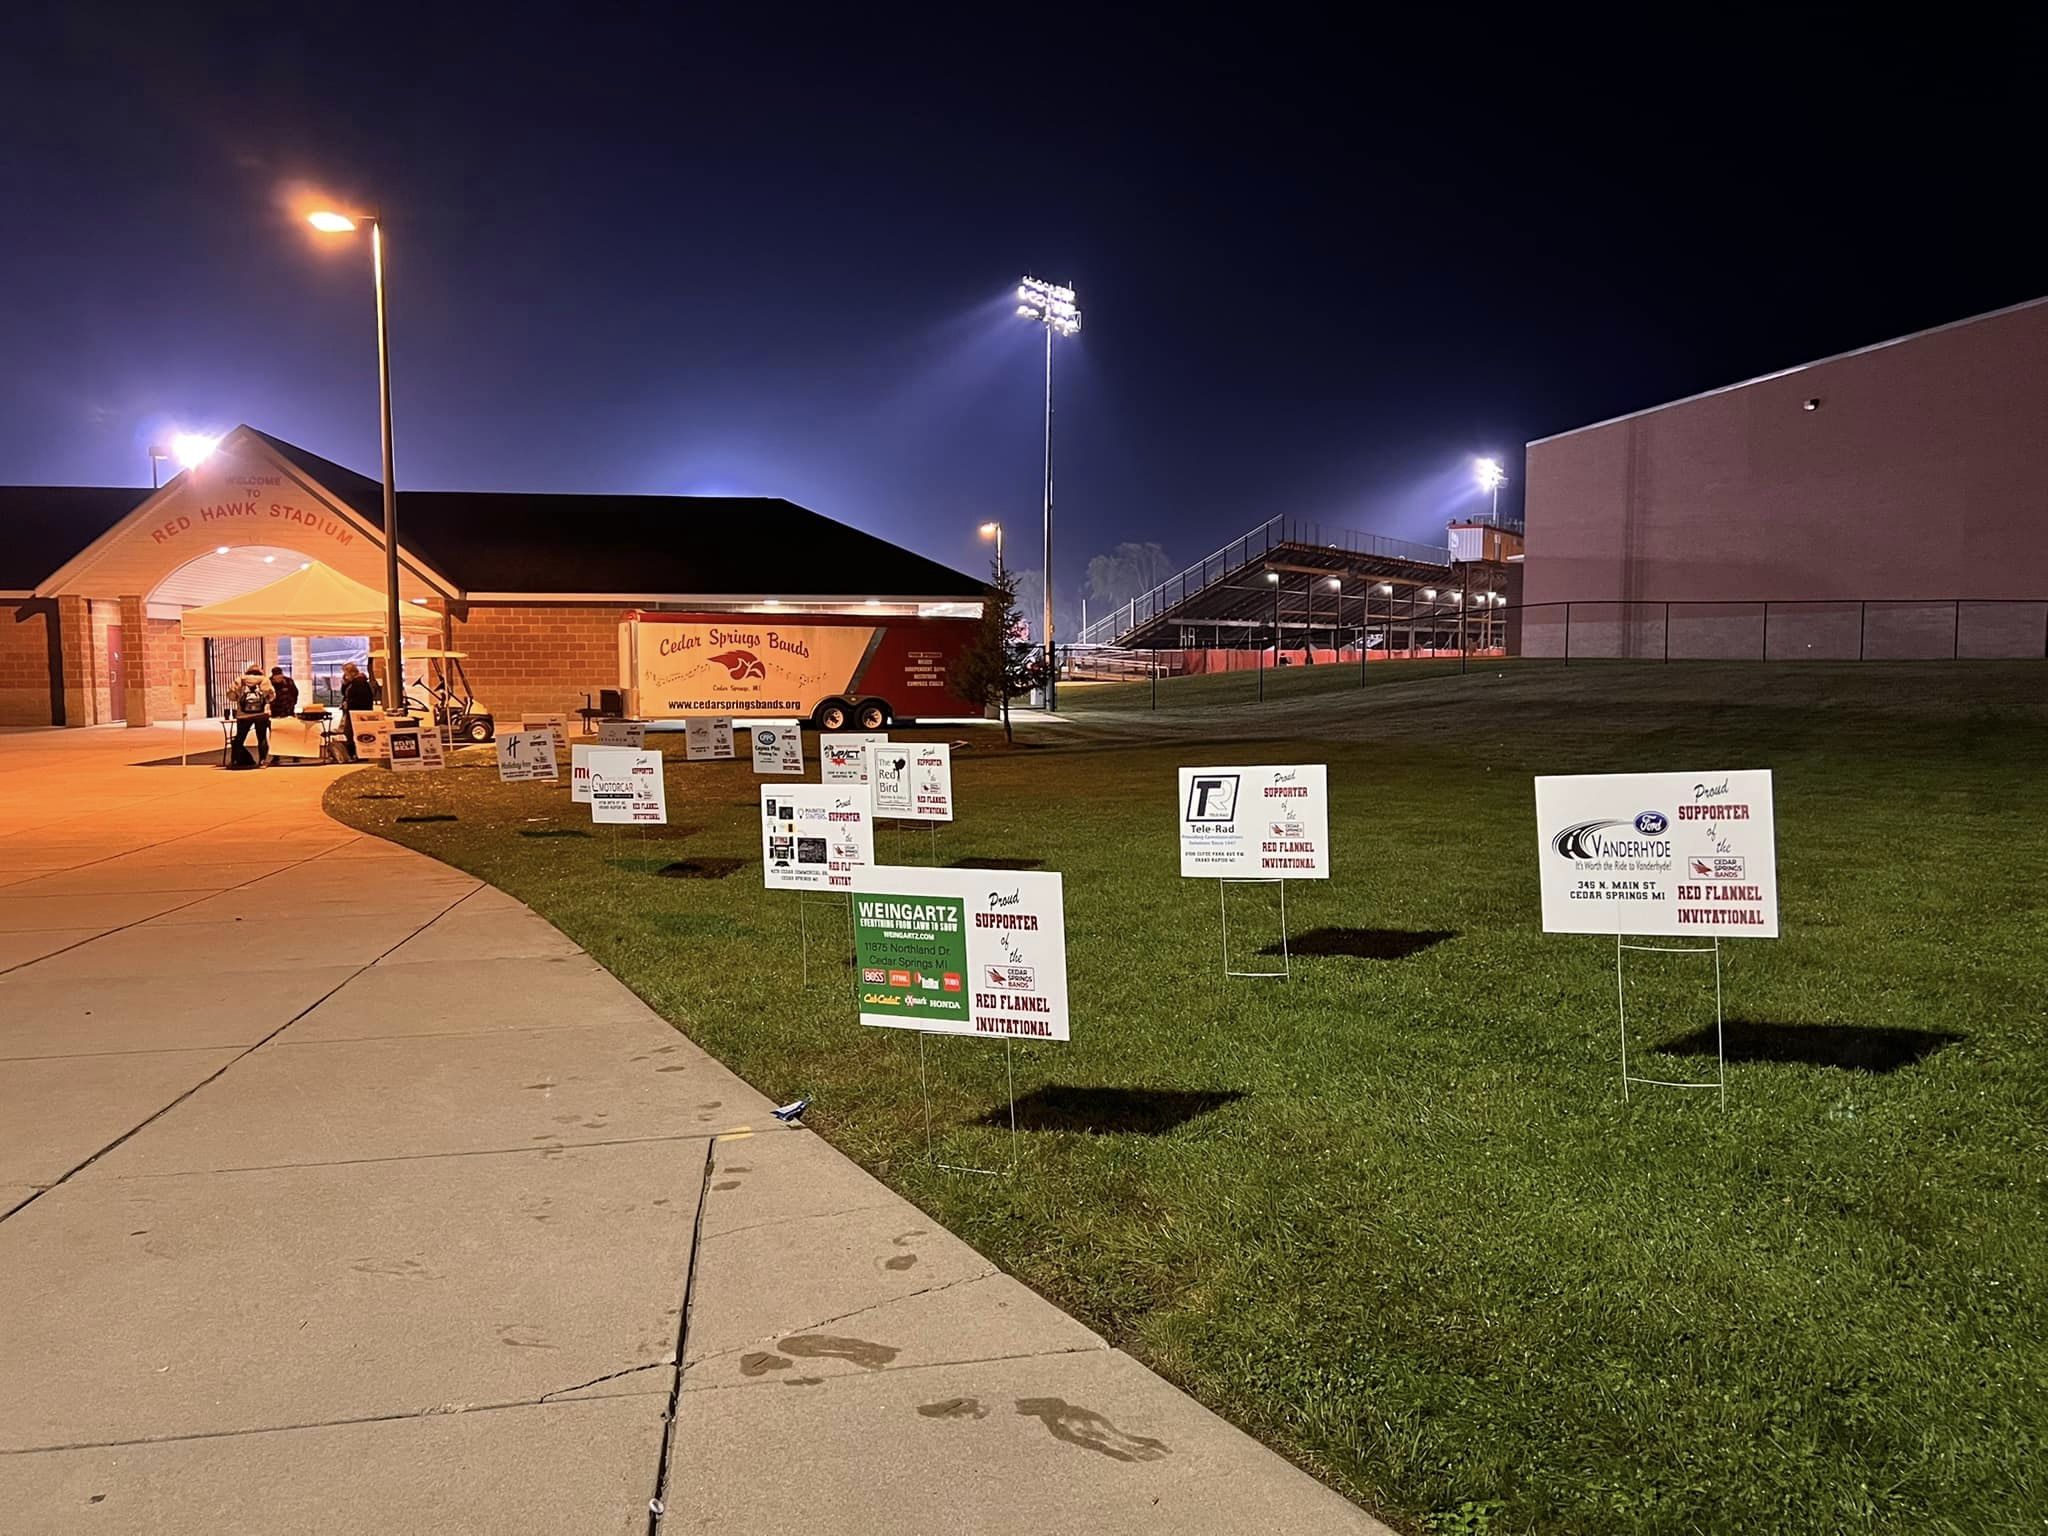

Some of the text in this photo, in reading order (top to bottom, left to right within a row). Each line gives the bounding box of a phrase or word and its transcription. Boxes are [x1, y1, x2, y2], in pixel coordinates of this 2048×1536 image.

[226, 476, 281, 486] WELCOME
[246, 489, 261, 498] TO
[151, 502, 353, 546] RED HAWK STADIUM
[660, 628, 809, 658] Cedar Springs Bands
[668, 699, 801, 711] www.cedarspringsbands.org
[879, 769, 896, 779] Red
[880, 782, 898, 793] Bird
[1264, 787, 1308, 797] SUPPORTER
[1694, 778, 1728, 803] Proud
[1678, 805, 1750, 820] SUPPORTER
[1191, 824, 1234, 833] Tele-Rad
[1706, 823, 1717, 841] of
[1262, 842, 1314, 852] RED FLANNEL
[1716, 838, 1731, 853] the
[1262, 858, 1315, 868] INVITATIONAL
[1614, 861, 1627, 871] Ride
[1578, 881, 1595, 889] 345
[1612, 881, 1639, 889] MAIN
[1643, 881, 1656, 889] ST
[988, 888, 1019, 911] Proud
[1570, 891, 1665, 900] CEDAR SPRINGS MI
[1678, 885, 1762, 901] RED FLANNEL
[859, 902, 958, 922] WEINGARTZ
[1678, 909, 1764, 924] INVITATIONAL
[975, 912, 1038, 931] SUPPORTER
[883, 931, 935, 940] WEINGARTZ.COM
[1001, 932, 1010, 950] of
[865, 942, 888, 952] 11875
[890, 943, 936, 955] Northland
[1010, 948, 1022, 963] the
[869, 955, 896, 965] Cedar
[898, 957, 933, 970] Springs
[864, 970, 884, 982] BOSS
[929, 1000, 960, 1009] HONDA
[976, 993, 1050, 1013] RED FLANNEL
[976, 1016, 1052, 1036] INVITATIONAL
